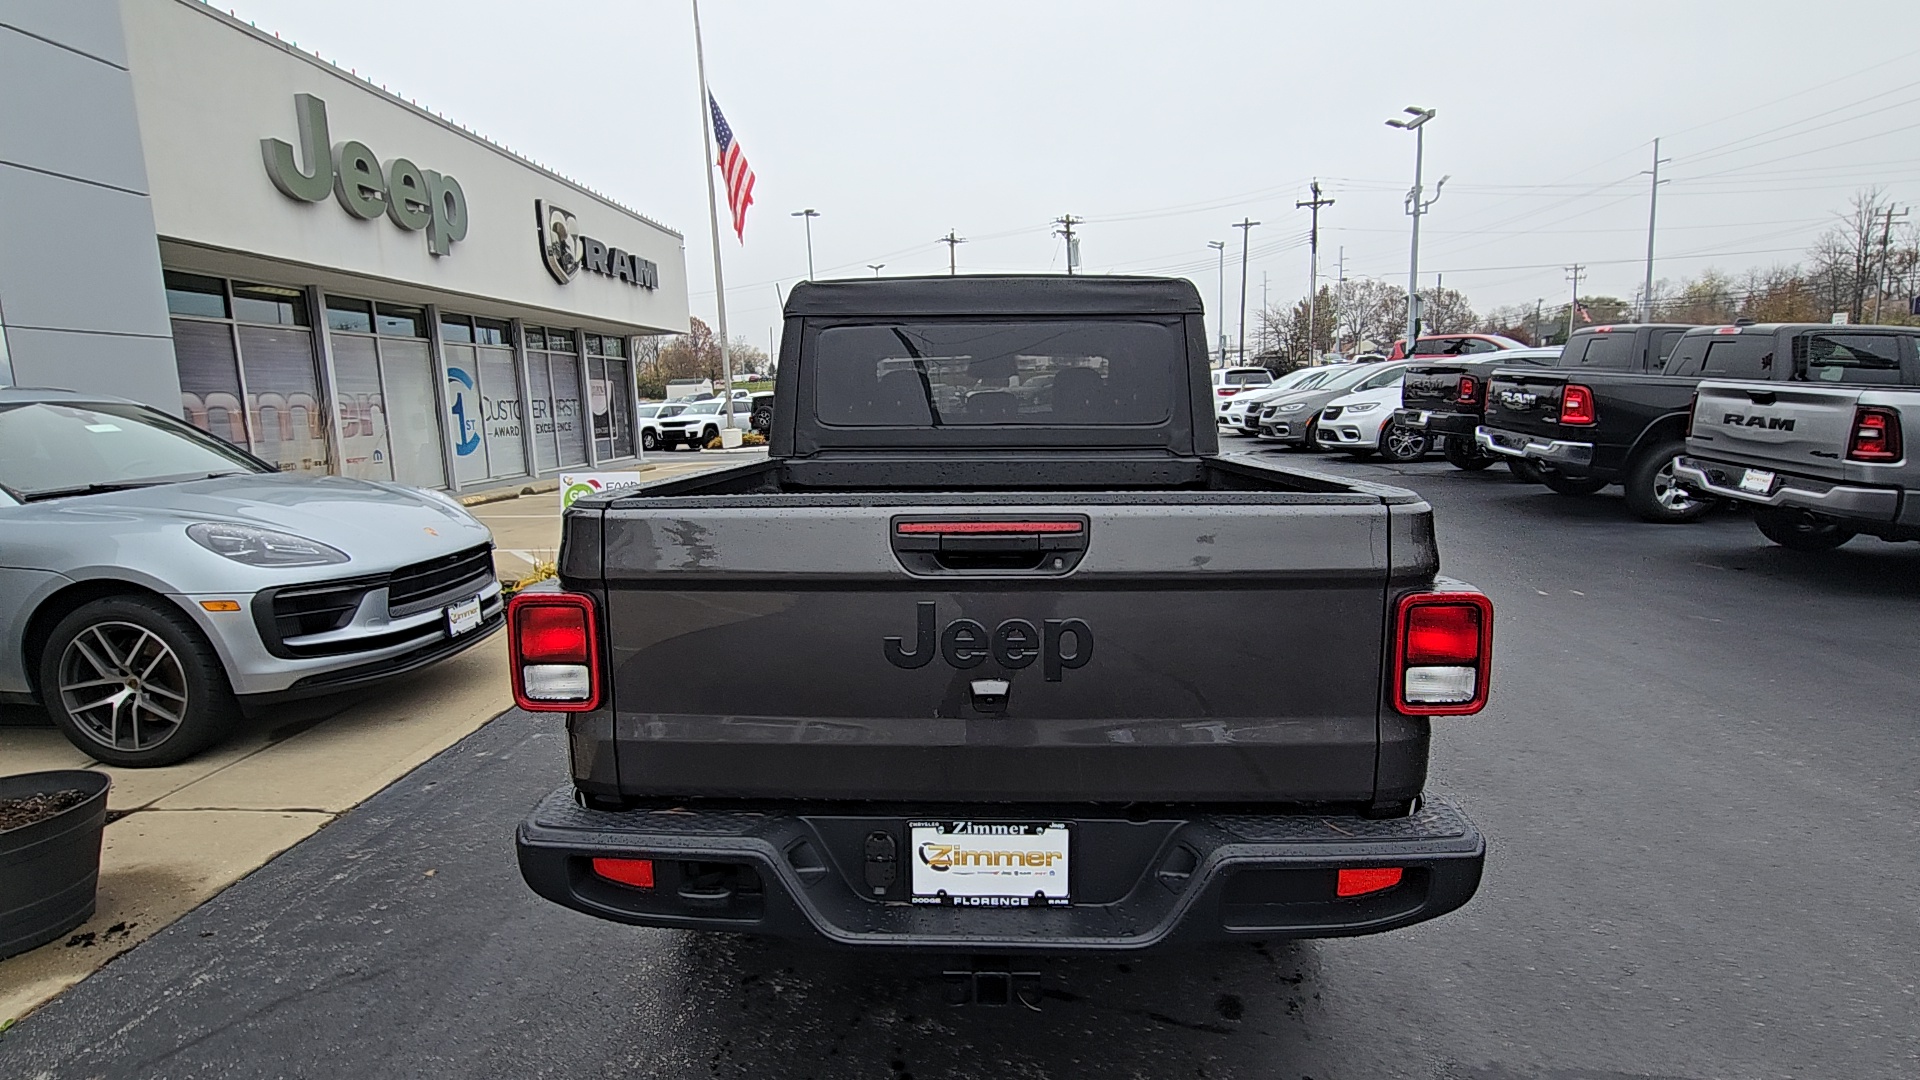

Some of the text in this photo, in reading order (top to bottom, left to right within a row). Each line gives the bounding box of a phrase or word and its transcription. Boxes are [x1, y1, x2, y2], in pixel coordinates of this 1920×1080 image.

[260, 93, 468, 257] Jeep
[579, 236, 659, 290] RAM
[1501, 391, 1537, 404] RAM
[480, 396, 547, 421] CUSTOER
[494, 425, 520, 437] AWARD
[1723, 413, 1796, 431] RAM
[883, 600, 1094, 682] Jeep
[952, 821, 1029, 835] Zimmer
[928, 844, 1063, 867] Zimmer
[953, 897, 1029, 906] FLORENCE
